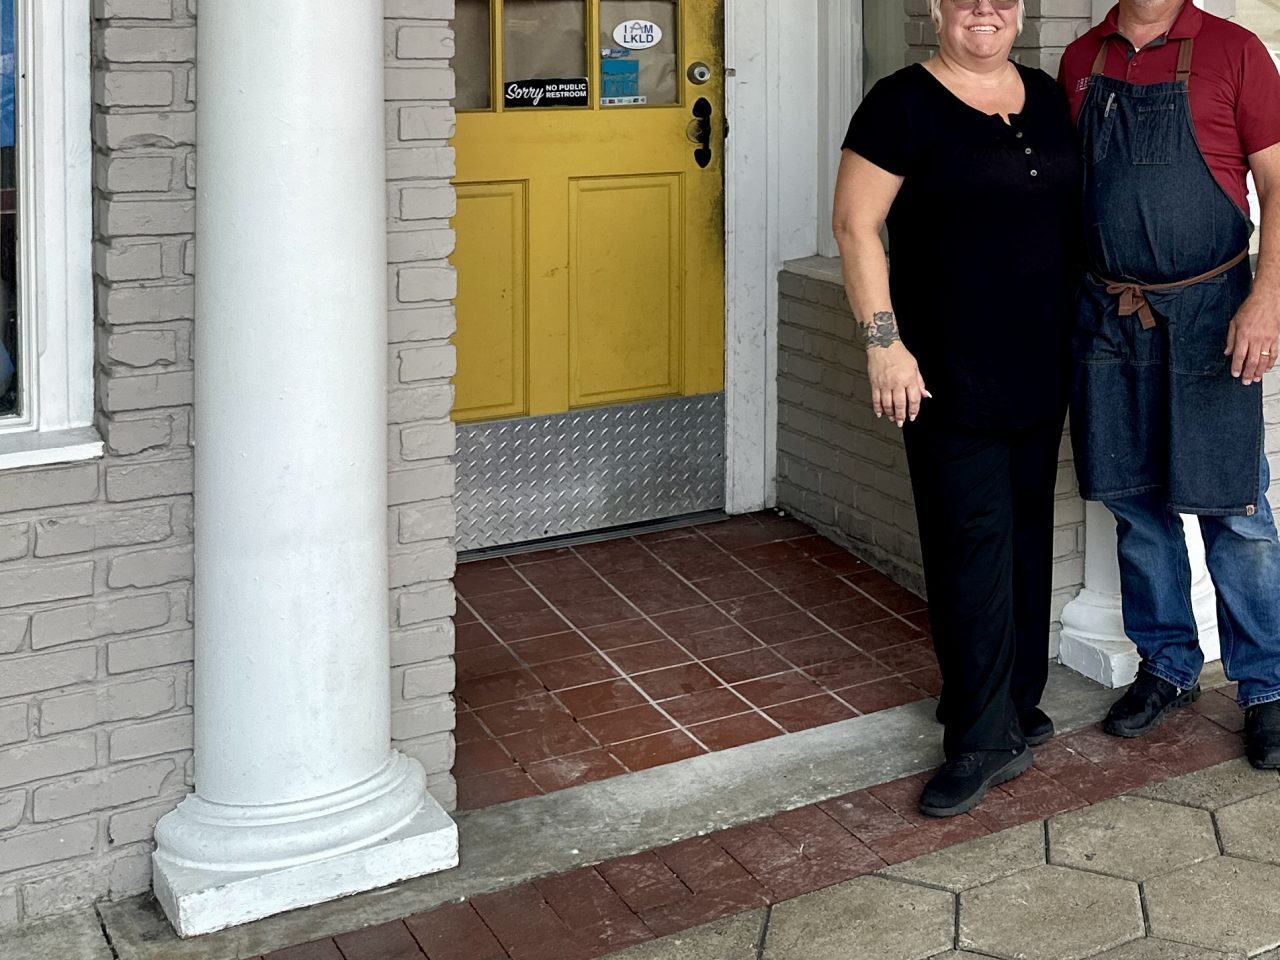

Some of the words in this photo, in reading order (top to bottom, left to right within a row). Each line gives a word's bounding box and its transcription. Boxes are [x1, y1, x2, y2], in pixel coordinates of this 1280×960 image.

[624, 24, 628, 34] I
[630, 22, 654, 34] AM
[623, 34, 654, 44] LKLD
[559, 83, 587, 91] PUBLIC
[505, 83, 545, 106] Sorry
